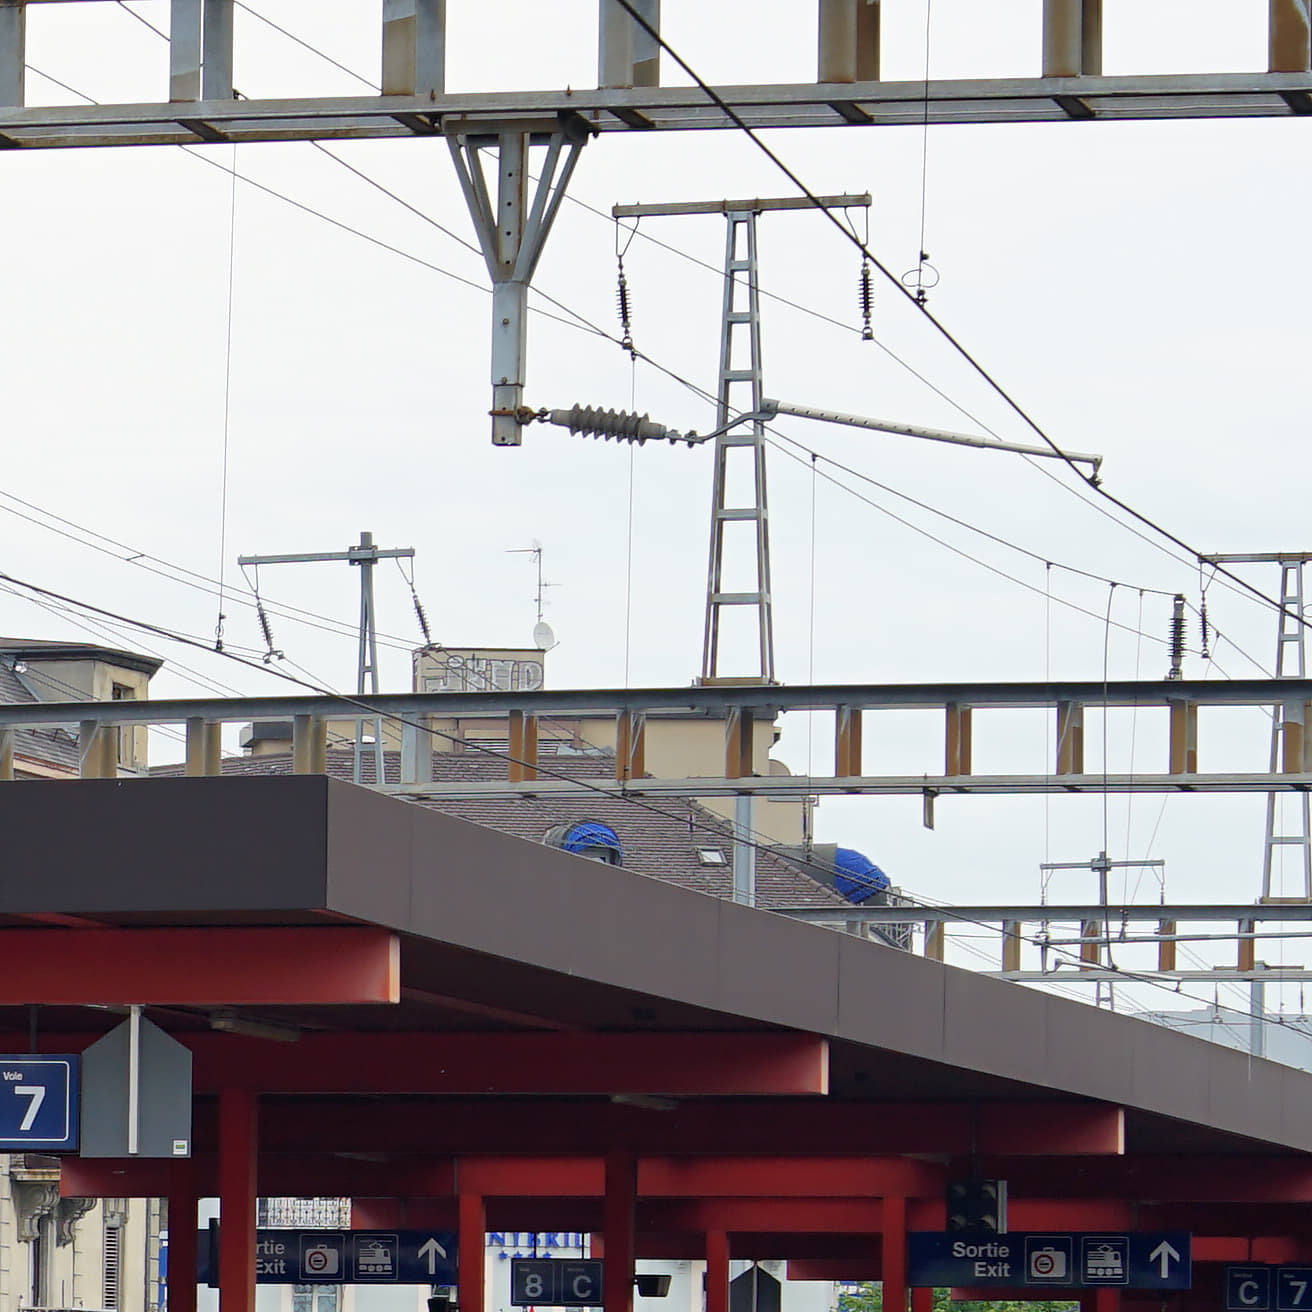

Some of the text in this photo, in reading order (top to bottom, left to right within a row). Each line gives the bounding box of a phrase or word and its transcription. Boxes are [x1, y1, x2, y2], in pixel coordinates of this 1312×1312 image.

[14, 1085, 46, 1131] 7
[256, 1240, 285, 1255] rtie
[952, 1241, 1010, 1258] Sortie
[256, 1259, 286, 1274] Exit
[974, 1261, 1011, 1277] Exit
[525, 1273, 543, 1298] 8
[573, 1274, 592, 1298] C
[1238, 1280, 1259, 1305] C
[1289, 1281, 1308, 1305] 7
